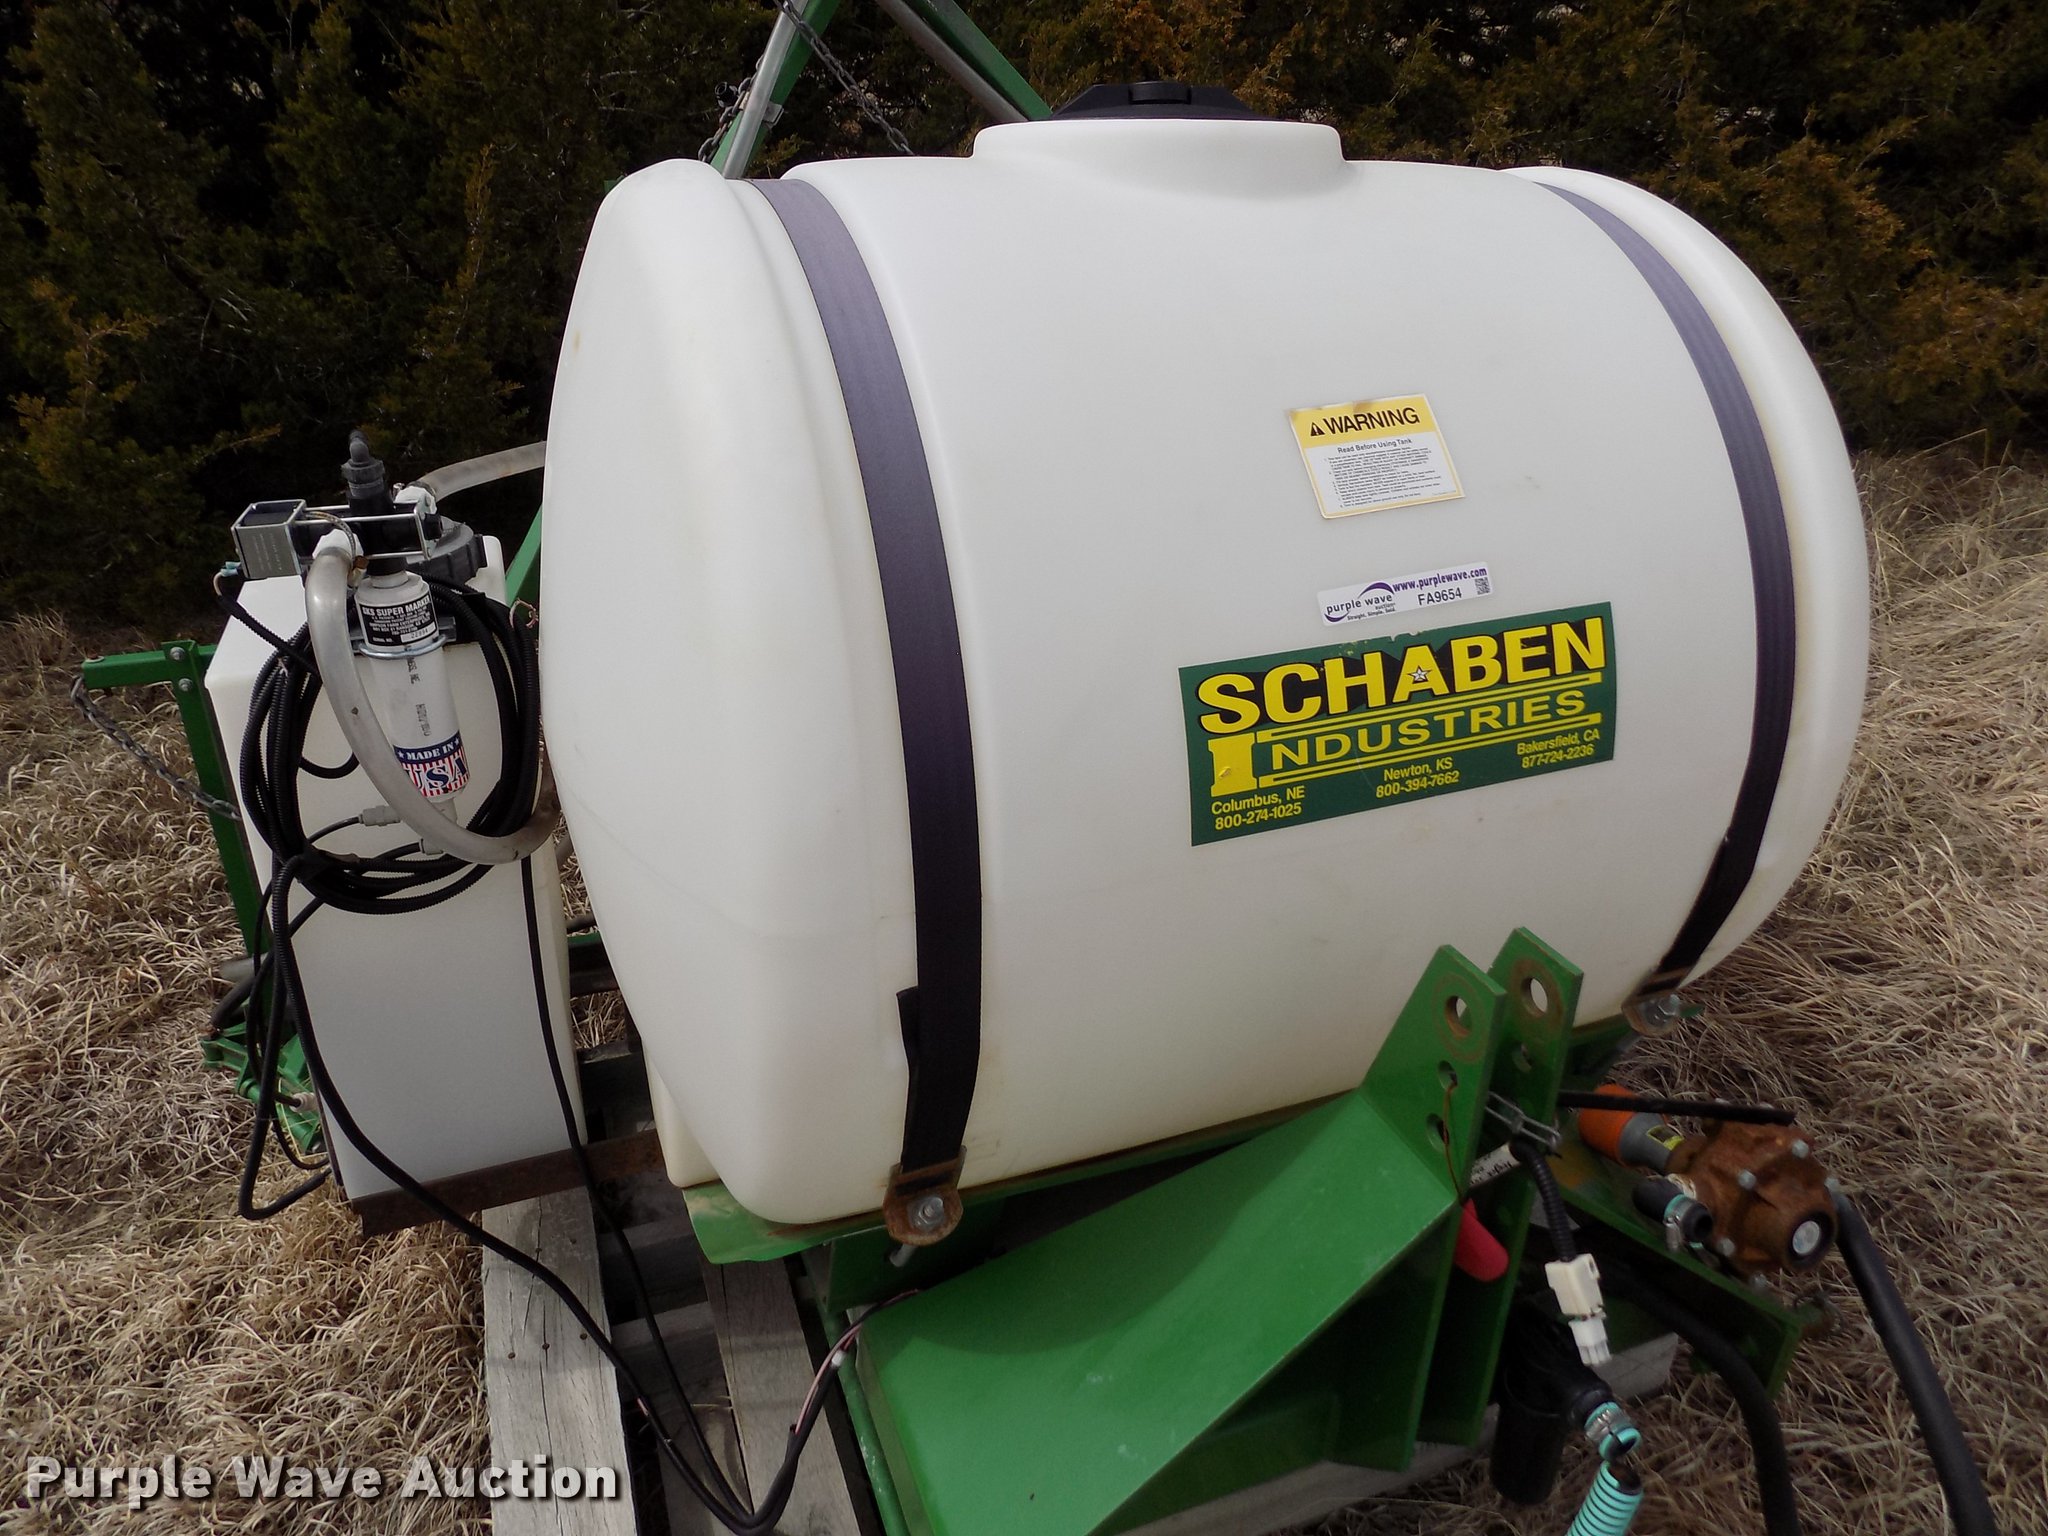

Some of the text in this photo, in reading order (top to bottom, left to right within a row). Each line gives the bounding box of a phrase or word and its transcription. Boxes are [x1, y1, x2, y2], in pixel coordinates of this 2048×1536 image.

[1323, 407, 1420, 434] WARNING
[1337, 445, 1355, 453] Read
[1355, 443, 1377, 451] Before
[1377, 440, 1397, 448] Using
[1392, 567, 1487, 593] www.purplewave.com
[1326, 594, 1392, 615] purple wave
[1418, 587, 1462, 606] FA9654
[376, 606, 404, 616] SUPER
[1198, 616, 1606, 735] SCHABEN
[406, 741, 454, 760] MADE IN
[1208, 689, 1586, 797] INDUSTRIES
[1516, 728, 1600, 755] Bakersfield, CA
[1383, 756, 1453, 781] Newton, KS
[1522, 743, 1594, 768] 877-724-2236
[404, 757, 467, 789] USA
[1376, 770, 1460, 798] 800-394-7662
[1211, 785, 1305, 815] Columbus, NE
[1215, 802, 1302, 830] 800-274-1025
